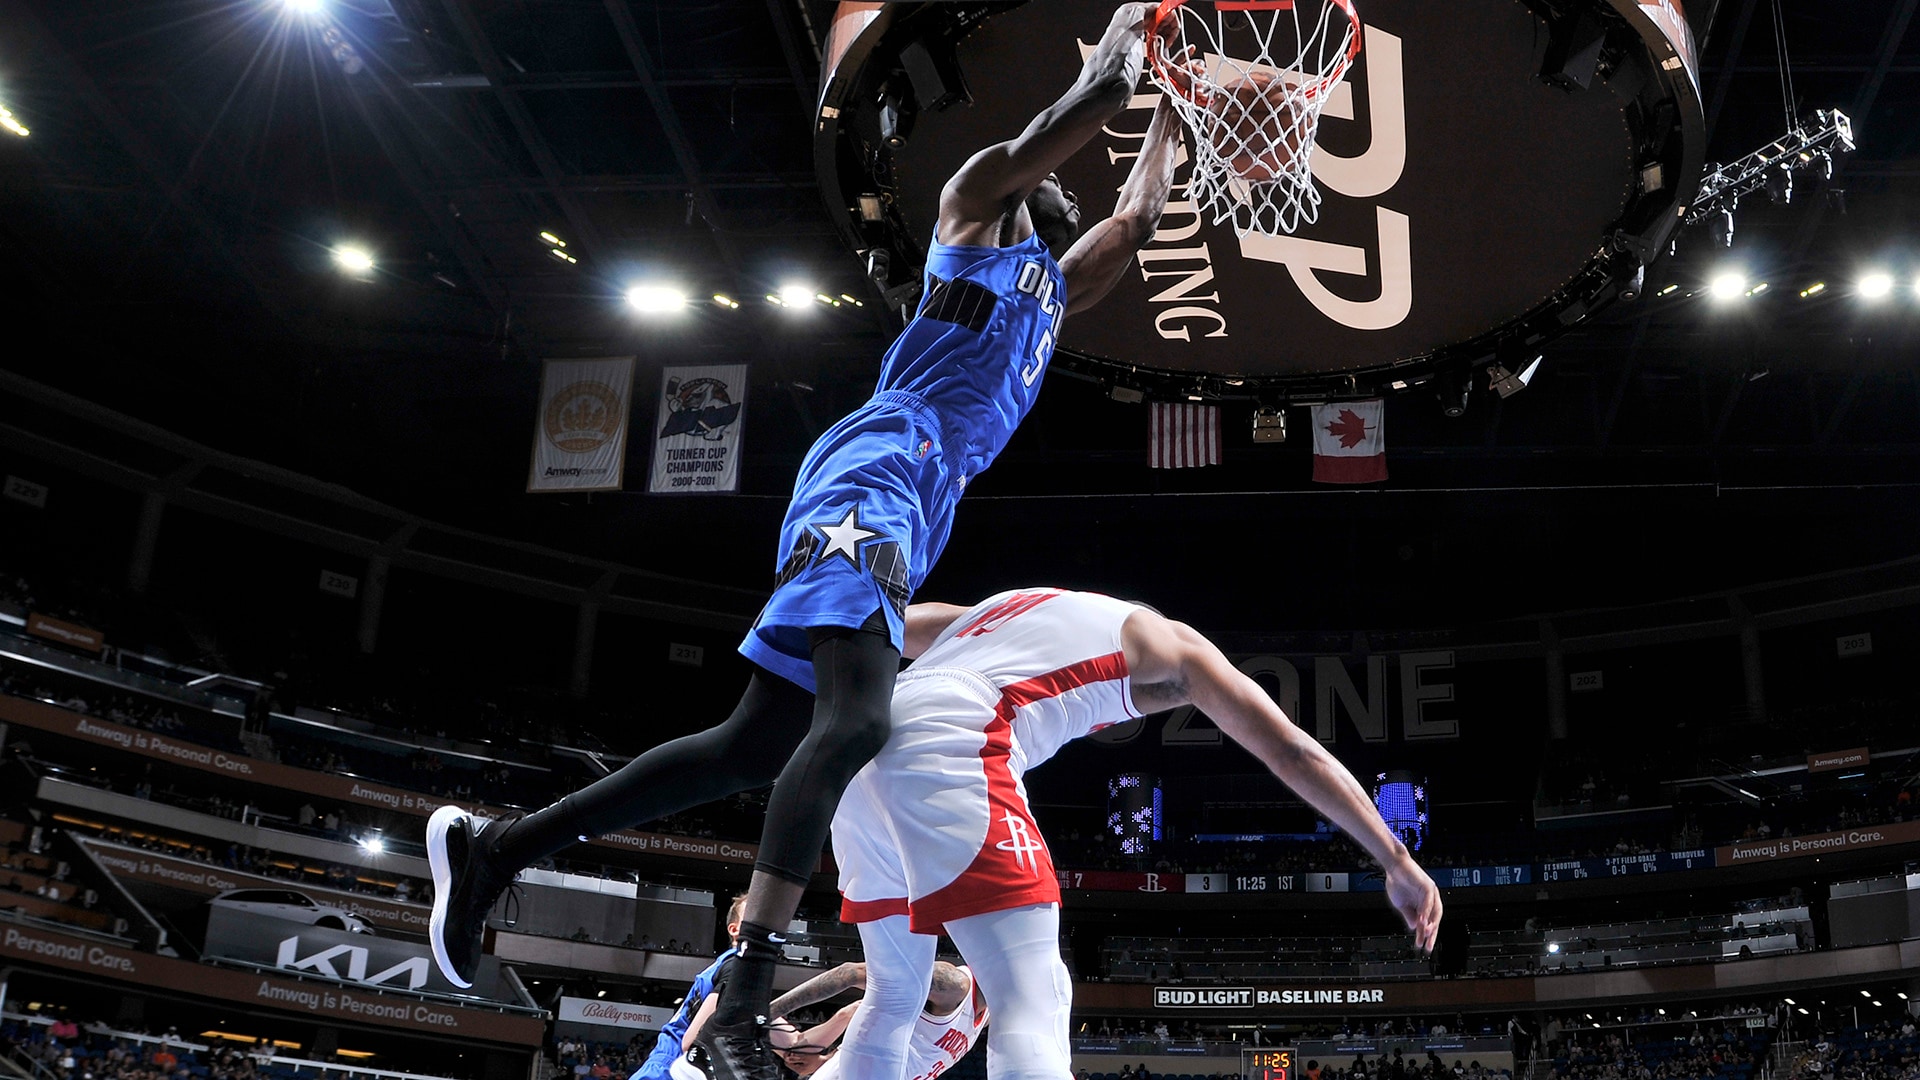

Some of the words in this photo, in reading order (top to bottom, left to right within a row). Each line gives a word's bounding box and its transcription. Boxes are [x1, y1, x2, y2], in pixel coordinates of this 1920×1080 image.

[1077, 38, 1229, 342] UDING
[1022, 329, 1052, 387] 5
[667, 448, 705, 460] TURNER
[708, 447, 727, 459] CUP
[545, 466, 581, 477] Amway
[667, 460, 724, 473] CHAMPIONS
[672, 476, 715, 487] 2000-2001
[327, 576, 350, 590] 230
[1844, 638, 1865, 650] 203
[676, 647, 697, 659] 231
[1577, 675, 1597, 686] 202
[75, 719, 134, 747] Amway
[135, 733, 148, 749] is
[150, 737, 212, 764] Personal
[214, 754, 253, 775] Care.
[1814, 754, 1862, 767] Amway.com
[351, 784, 400, 808] Amway
[402, 794, 414, 808] is
[601, 833, 648, 849] Amway
[650, 836, 661, 849] is
[663, 838, 717, 855] Personal
[720, 844, 754, 860] Care.
[1732, 845, 1777, 860] Amway
[1779, 841, 1790, 853] is
[1792, 834, 1846, 851] Personal
[1849, 831, 1884, 844] Care.
[93, 851, 138, 873] Amway
[139, 860, 150, 873] is
[152, 864, 205, 885] Personal
[1495, 866, 1510, 876] TIME
[1612, 864, 1627, 875] 0-0
[1643, 862, 1657, 872] 0%
[1686, 858, 1692, 869] 0
[1452, 868, 1468, 877] TEAM
[1472, 869, 1481, 885] 0
[1513, 867, 1522, 882] 7
[1543, 870, 1558, 881] 0-0
[1574, 868, 1588, 879] 0%
[1075, 873, 1082, 888] 7
[1203, 876, 1210, 890] 3
[1235, 876, 1267, 890] 11:25
[1277, 875, 1294, 890] 1ST
[1325, 875, 1332, 890] 0
[1452, 877, 1470, 887] FOULS
[1495, 875, 1511, 886] OUTS
[350, 902, 399, 920] Personal
[4, 929, 86, 962] Personal
[88, 947, 136, 972] Care.
[257, 981, 320, 1008] Amway
[323, 991, 336, 1009] is
[340, 995, 410, 1020] Personal
[414, 1006, 458, 1027] Care.
[1157, 990, 1196, 1004] BUD
[1198, 990, 1251, 1004] LIGHT
[1257, 990, 1343, 1004] BASELINE
[1346, 989, 1384, 1003] BAR
[582, 1002, 622, 1023] Bally
[623, 1012, 652, 1023] SPORTS
[1254, 1051, 1291, 1068] 11:25
